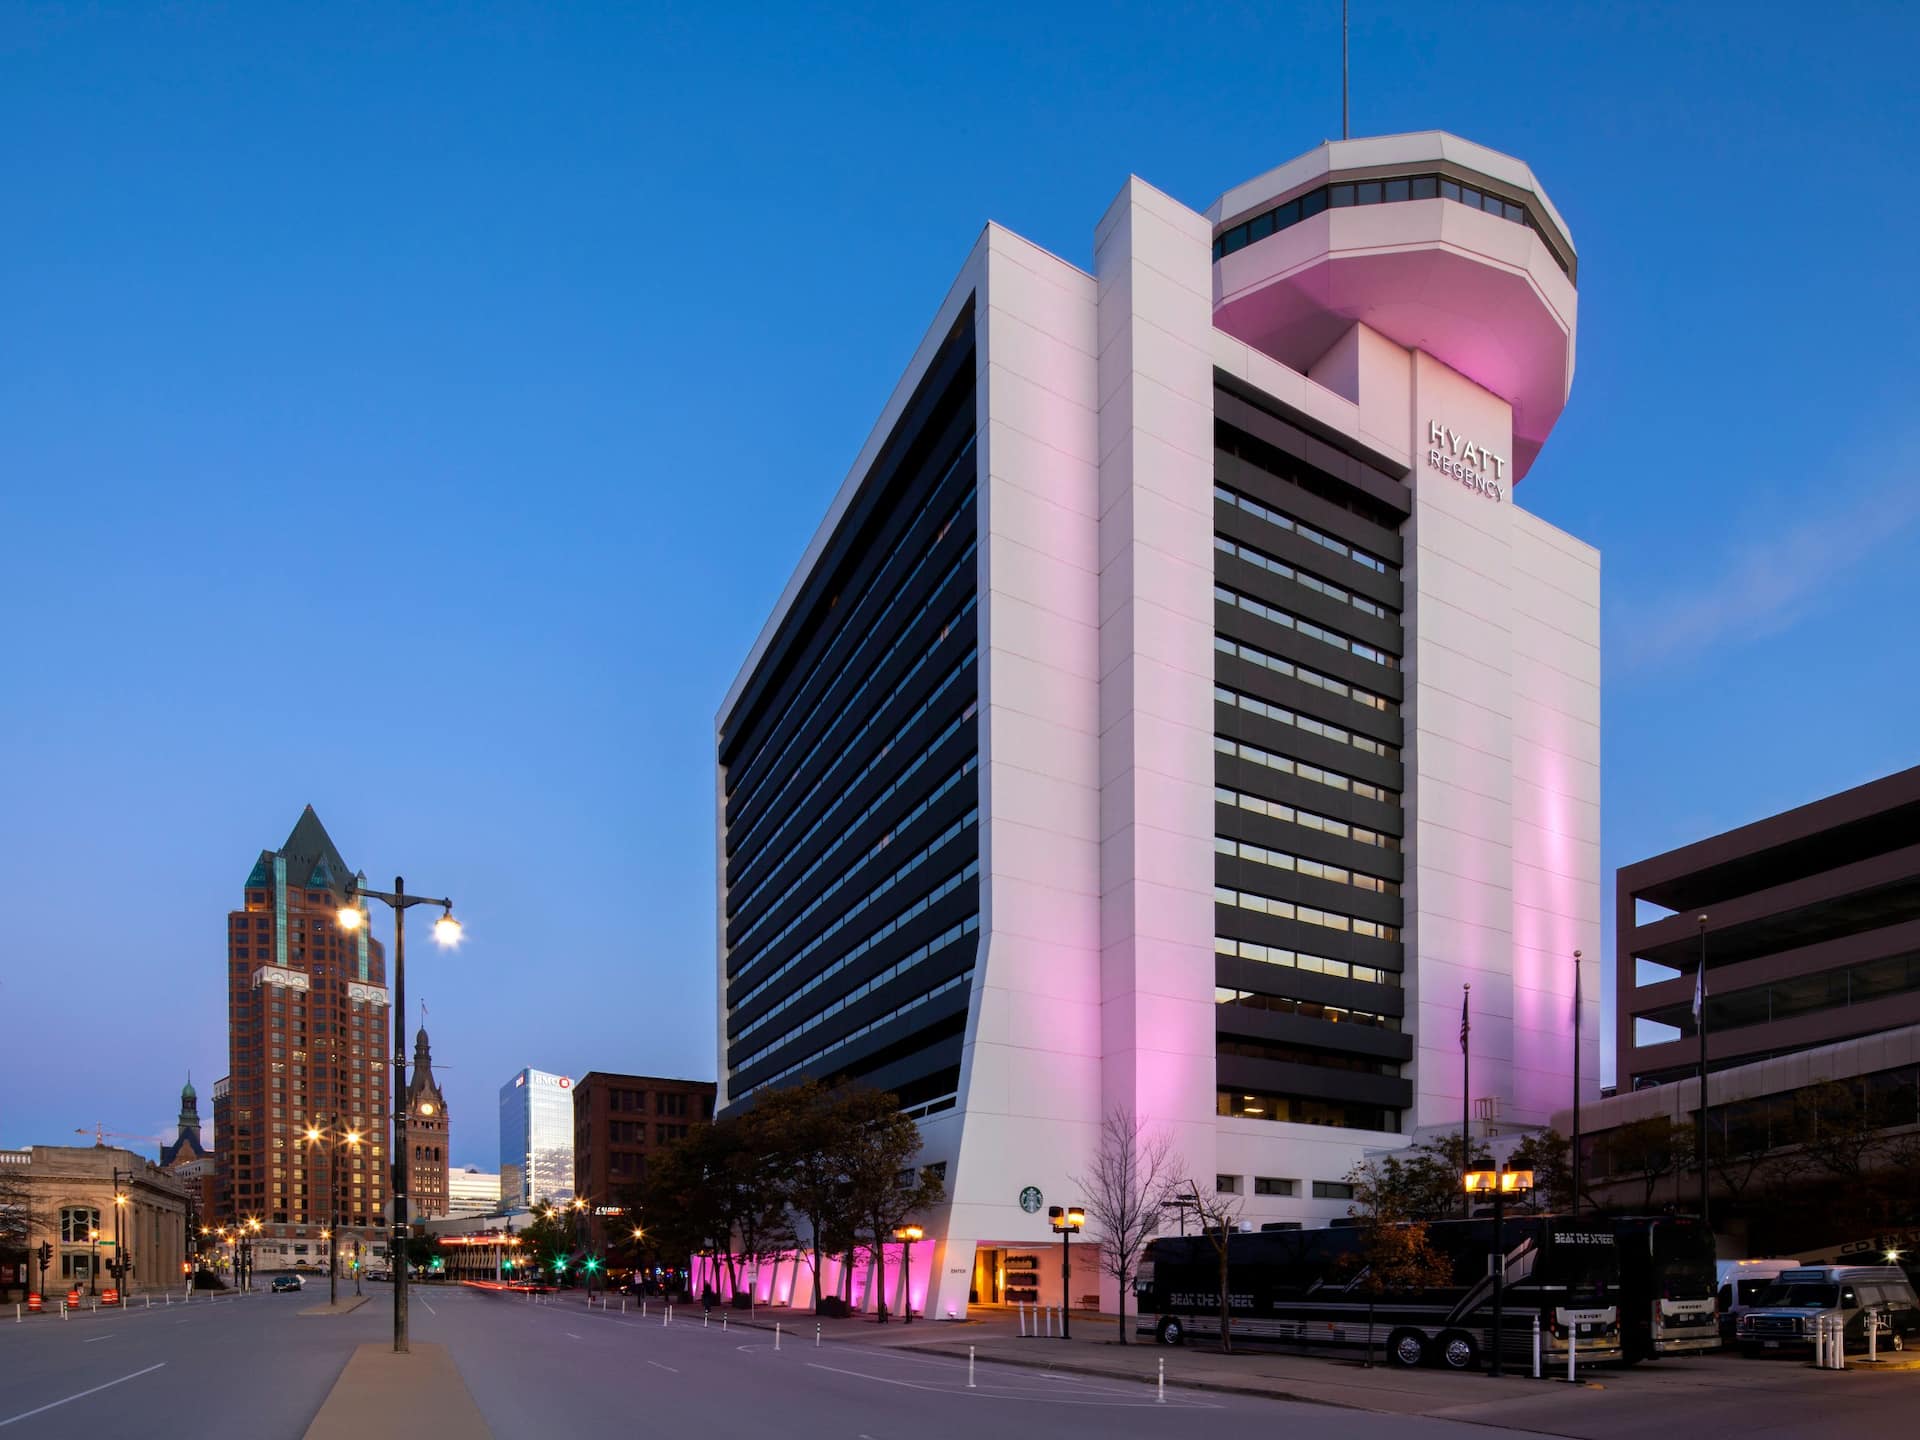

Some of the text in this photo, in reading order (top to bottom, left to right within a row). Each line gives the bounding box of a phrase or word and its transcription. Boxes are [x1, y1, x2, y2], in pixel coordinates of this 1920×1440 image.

[1430, 420, 1505, 480] HYATT
[1429, 449, 1505, 502] REGENCY
[1554, 1233, 1575, 1244] BEAT
[1575, 1233, 1590, 1244] THE
[1170, 1293, 1255, 1308] BEAT THE SREET
